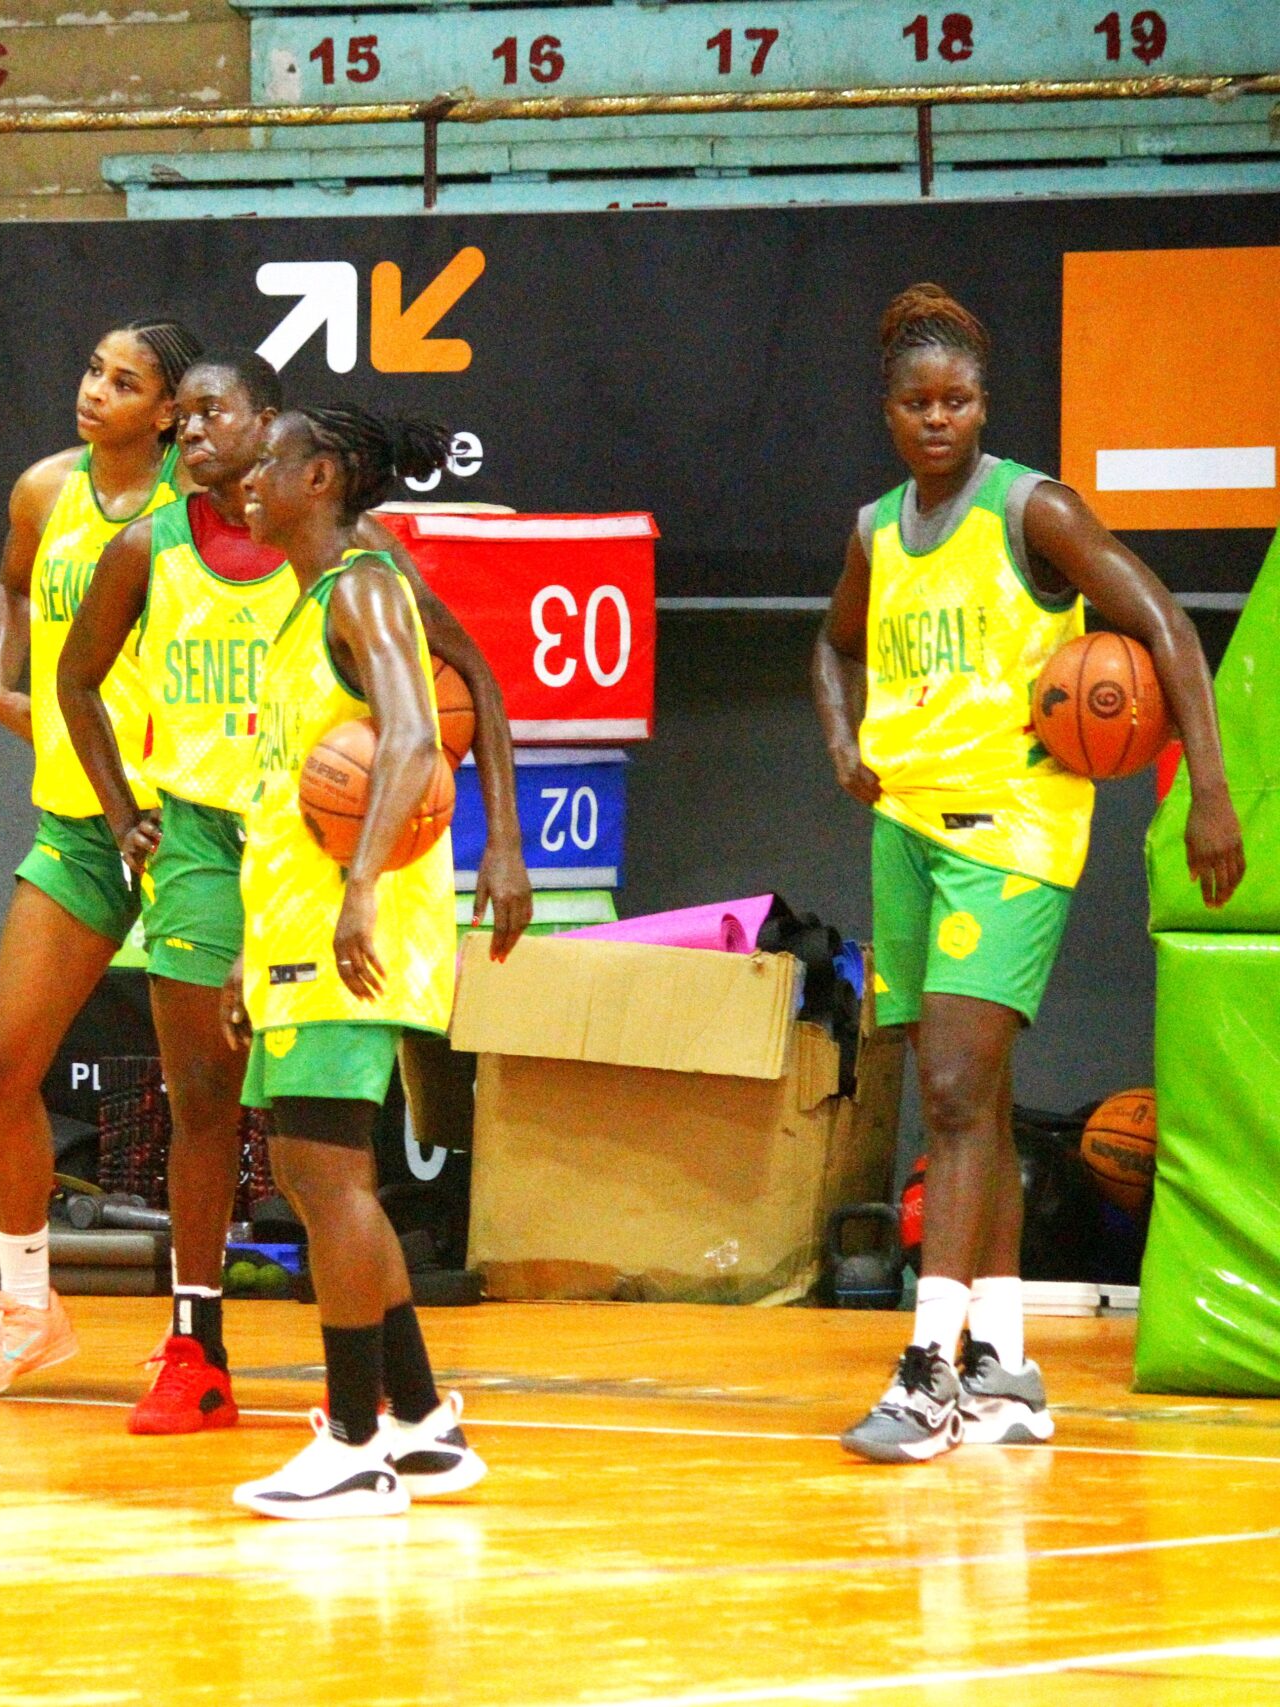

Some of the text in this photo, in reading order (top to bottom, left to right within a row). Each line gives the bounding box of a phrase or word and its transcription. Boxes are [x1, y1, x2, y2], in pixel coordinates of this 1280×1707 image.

[310, 35, 380, 84] 15
[492, 35, 565, 84] 16
[707, 27, 779, 75] 17
[902, 13, 974, 62] 18
[1094, 10, 1167, 65] 19
